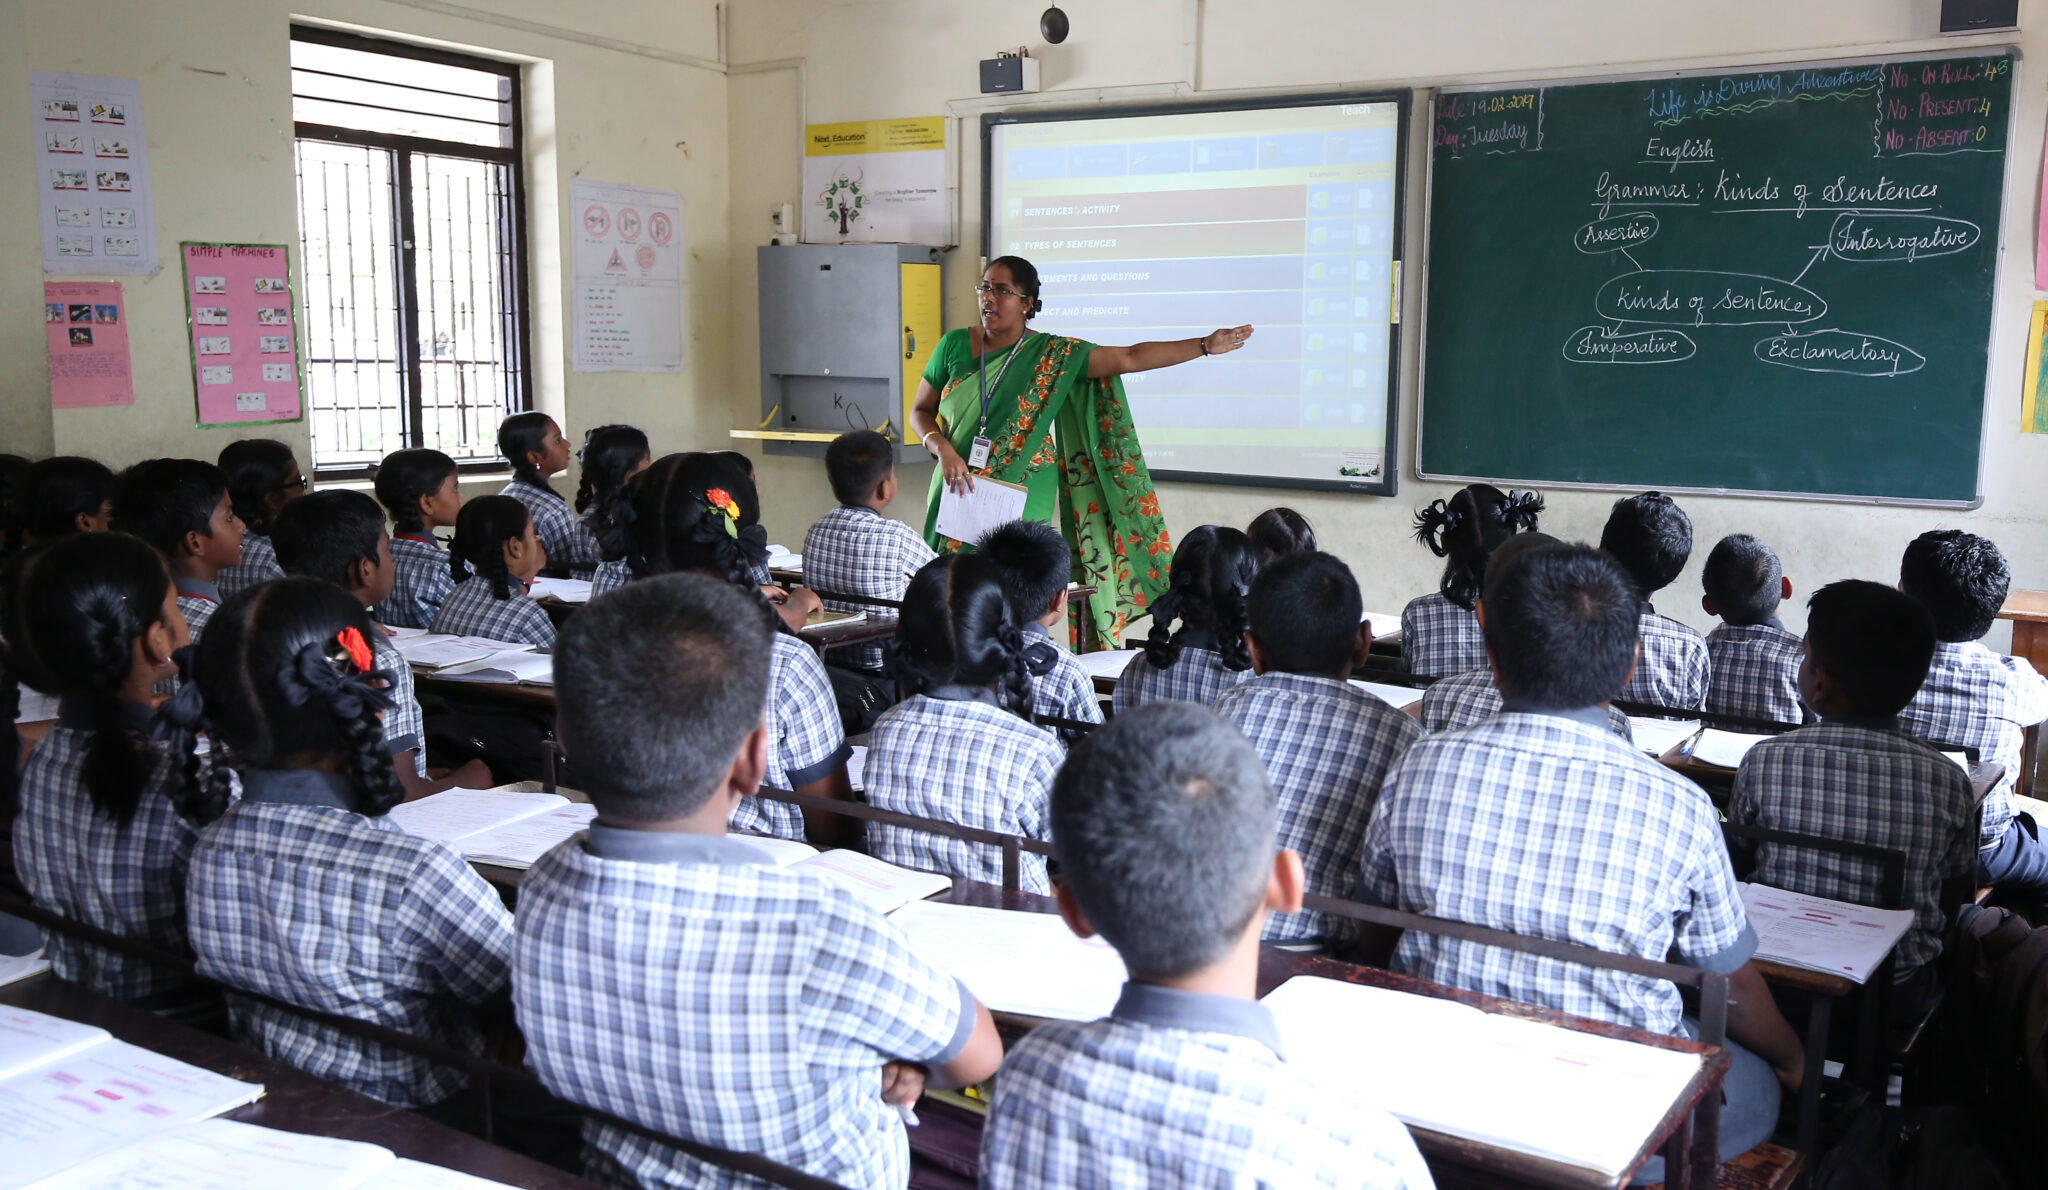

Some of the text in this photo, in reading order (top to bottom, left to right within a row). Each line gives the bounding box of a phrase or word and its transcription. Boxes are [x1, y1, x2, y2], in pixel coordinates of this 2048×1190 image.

[1644, 66, 1881, 122] Life is Daring Adventure
[833, 133, 866, 143] Education
[1467, 120, 1529, 149] Tuesday
[1646, 138, 1714, 173] English
[1024, 207, 1073, 217] SENTENCES
[1081, 204, 1120, 215] ACTIVITY
[1794, 184, 1813, 219] of
[1822, 176, 1938, 202] Sentences
[1024, 241, 1050, 250] TYPES
[1052, 240, 1063, 249] OF
[1067, 239, 1117, 249] SENTENCES
[1583, 222, 1650, 245] Assertive
[1836, 219, 1967, 262] Interrogative
[190, 246, 275, 258] SIMPLE MACHINES
[1080, 273, 1098, 282] AND
[1101, 272, 1150, 281] QUESTIONS
[1062, 307, 1080, 316] AND
[1082, 306, 1129, 316] PREDICATE
[1688, 296, 1706, 327] of
[1577, 330, 1678, 363] Imperative
[1768, 337, 1900, 377] Exclamatory
